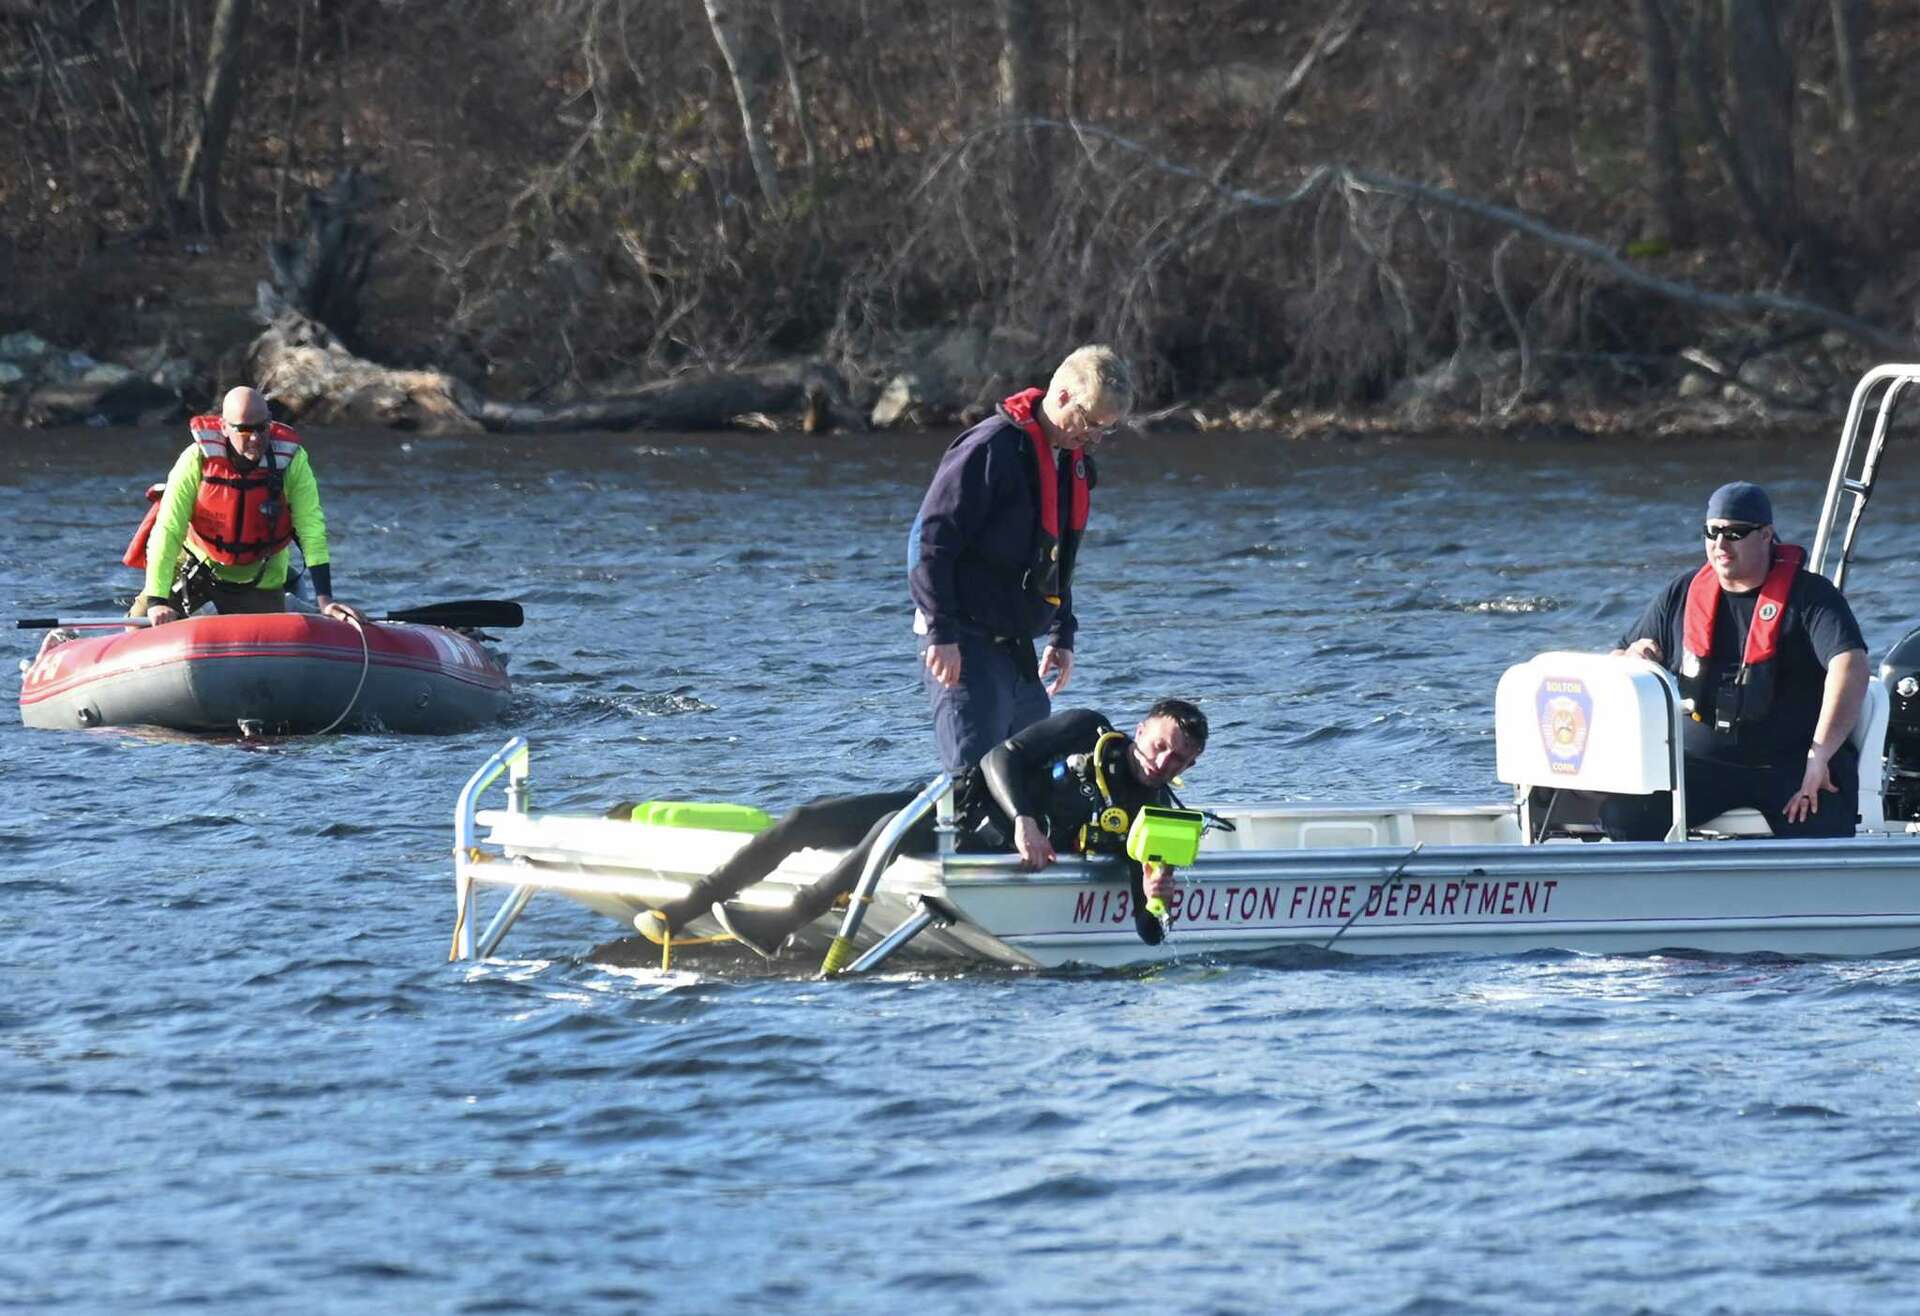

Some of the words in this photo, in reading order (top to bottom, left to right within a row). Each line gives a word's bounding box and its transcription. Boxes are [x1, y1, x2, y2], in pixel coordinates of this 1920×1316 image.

[1072, 890, 1136, 924] M13
[1289, 885, 1356, 919] FIRE
[1364, 880, 1558, 917] DEPARTMENT
